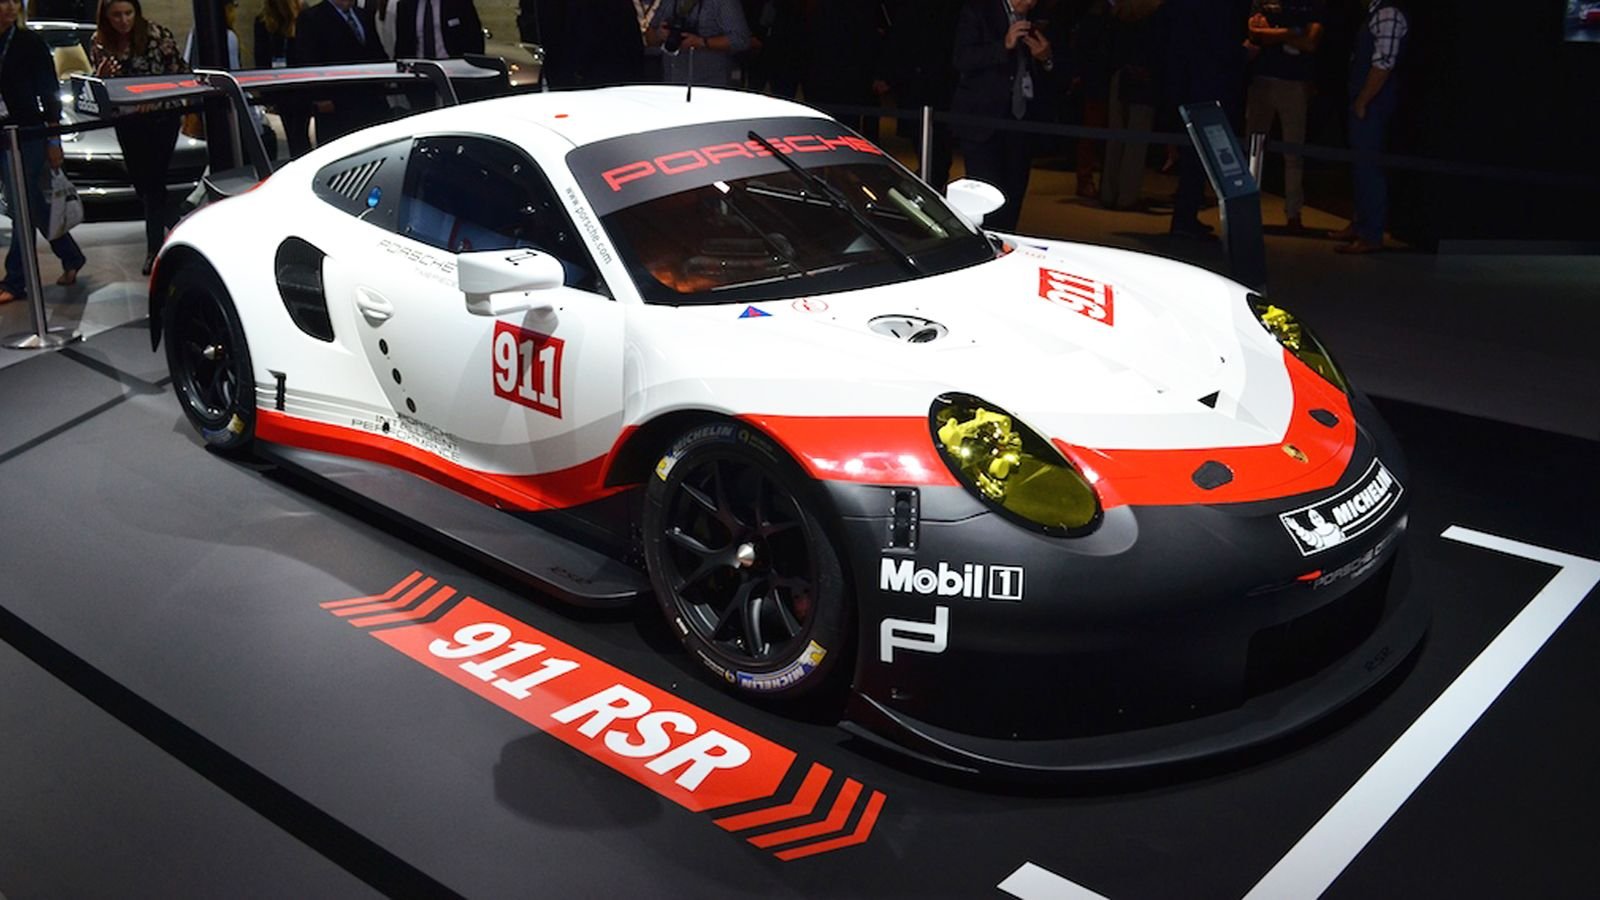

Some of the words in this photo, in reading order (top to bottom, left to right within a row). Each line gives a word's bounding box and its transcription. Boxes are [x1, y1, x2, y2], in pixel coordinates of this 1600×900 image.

[602, 135, 883, 193] PORSCHE
[565, 187, 613, 265] www.porsche.com
[1046, 271, 1107, 319] 911
[494, 331, 559, 409] 911
[1331, 466, 1393, 526] MICHELIN
[880, 557, 984, 598] Mobil
[428, 622, 580, 700] 911
[550, 683, 751, 792] RSR
[740, 665, 805, 690] MICHELIN
